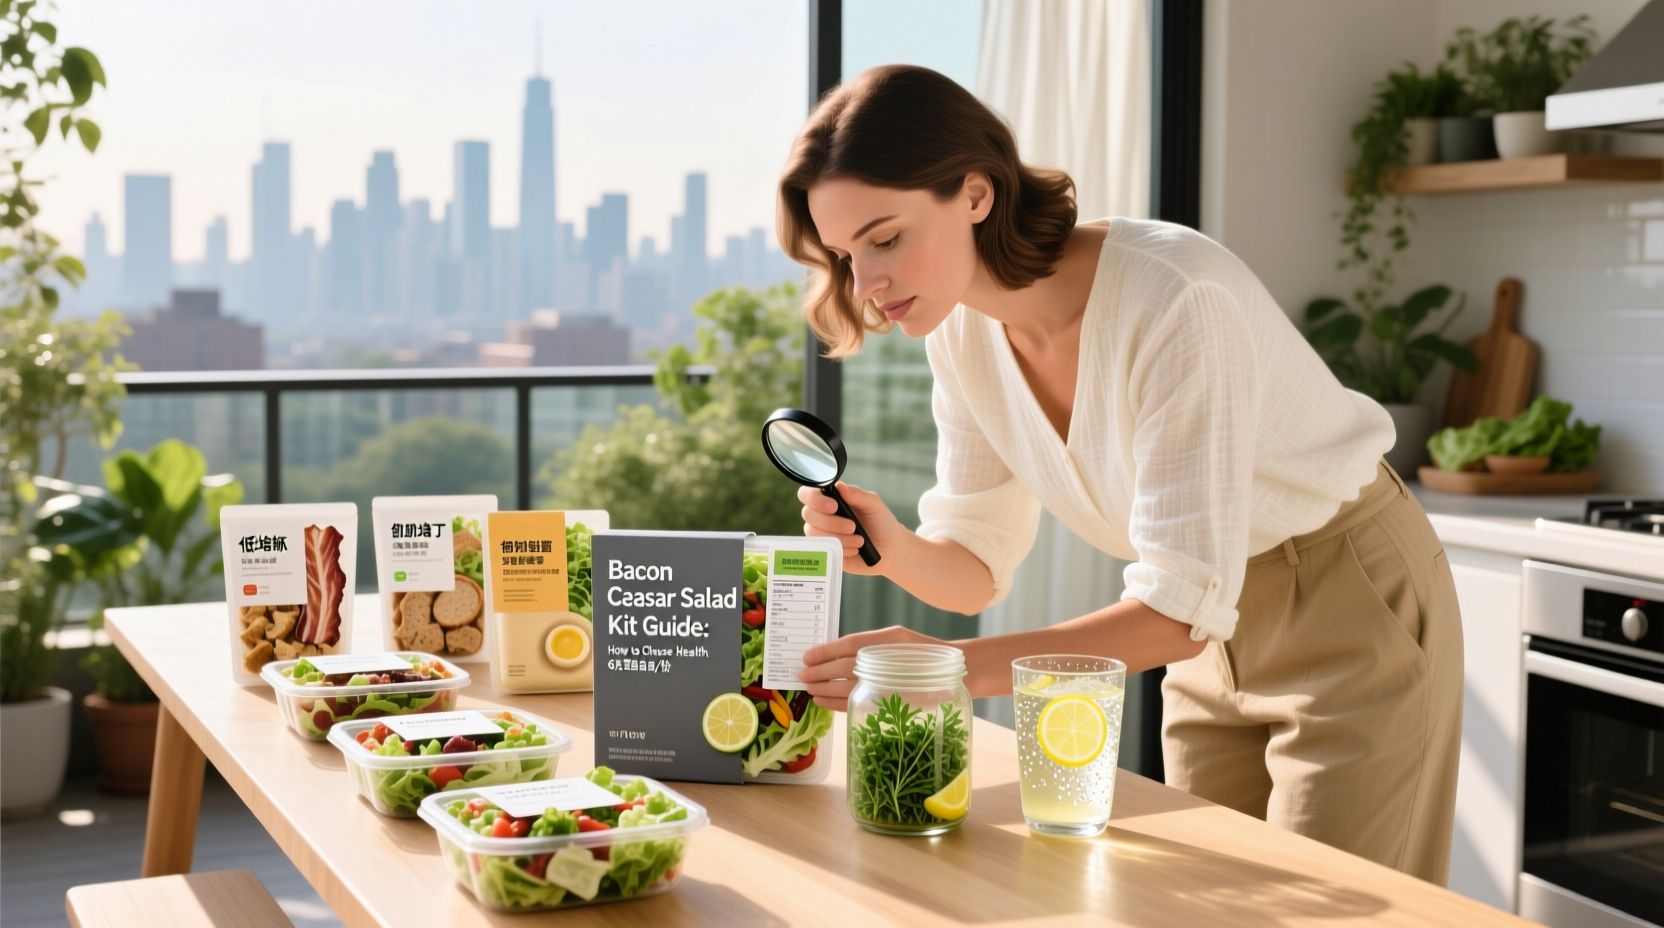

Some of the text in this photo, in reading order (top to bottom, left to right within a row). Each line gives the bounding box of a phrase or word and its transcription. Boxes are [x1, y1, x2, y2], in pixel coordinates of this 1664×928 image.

[609, 559, 673, 581] Bacon
[680, 586, 737, 609] Salad
[608, 614, 709, 638] Kit Guide:
